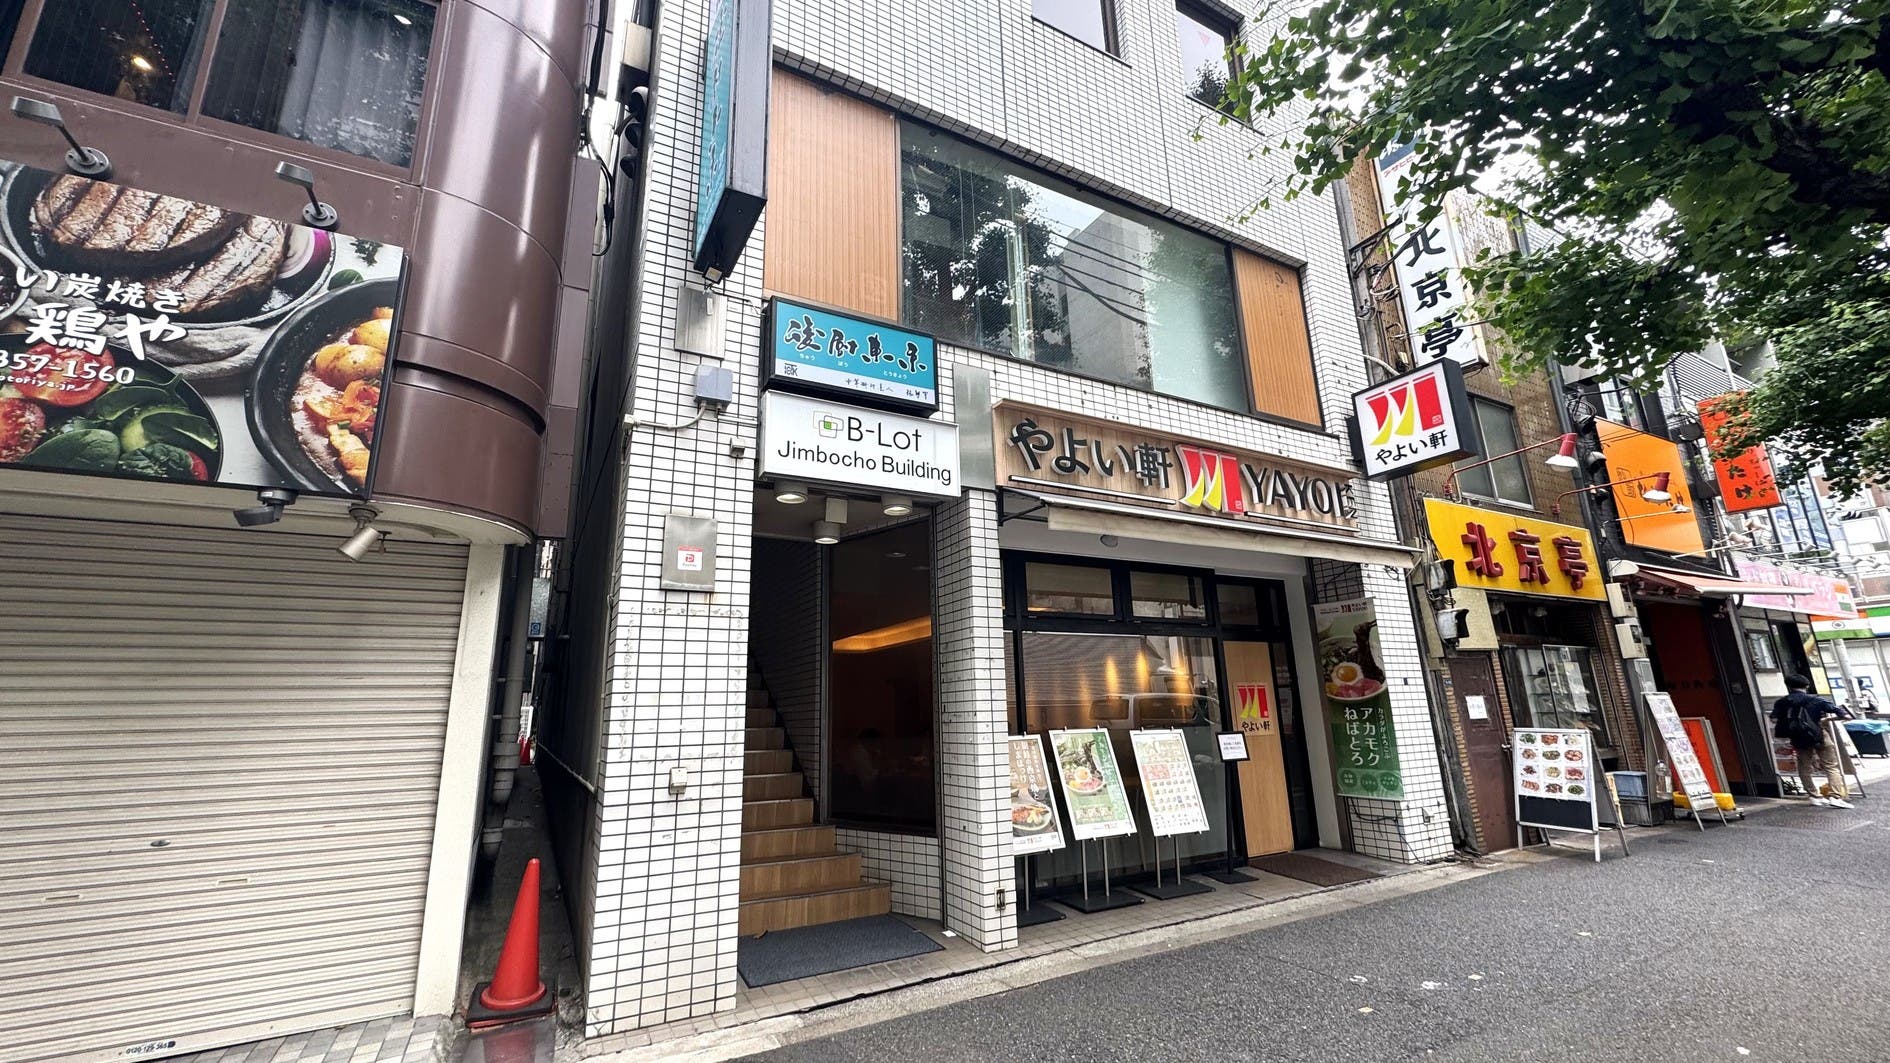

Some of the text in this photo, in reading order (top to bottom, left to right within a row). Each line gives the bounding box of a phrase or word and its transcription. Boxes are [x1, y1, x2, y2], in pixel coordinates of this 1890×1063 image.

[1384, 154, 1417, 178] アサヒビ
[0, 267, 187, 313] い炭焼き
[1406, 228, 1464, 358] 北京亭
[25, 303, 187, 361] 鶏や
[848, 416, 922, 452] B-Lot
[1009, 417, 1174, 489] やよい軒
[1375, 430, 1448, 467] やよい軒
[778, 440, 951, 486] Jimbocho Building
[1241, 463, 1345, 519] YAYOI
[1461, 521, 1589, 592] 北京亭
[1241, 720, 1270, 733] やよい軒
[1344, 706, 1364, 767] ねばとろ
[1360, 707, 1380, 766] アカモク
